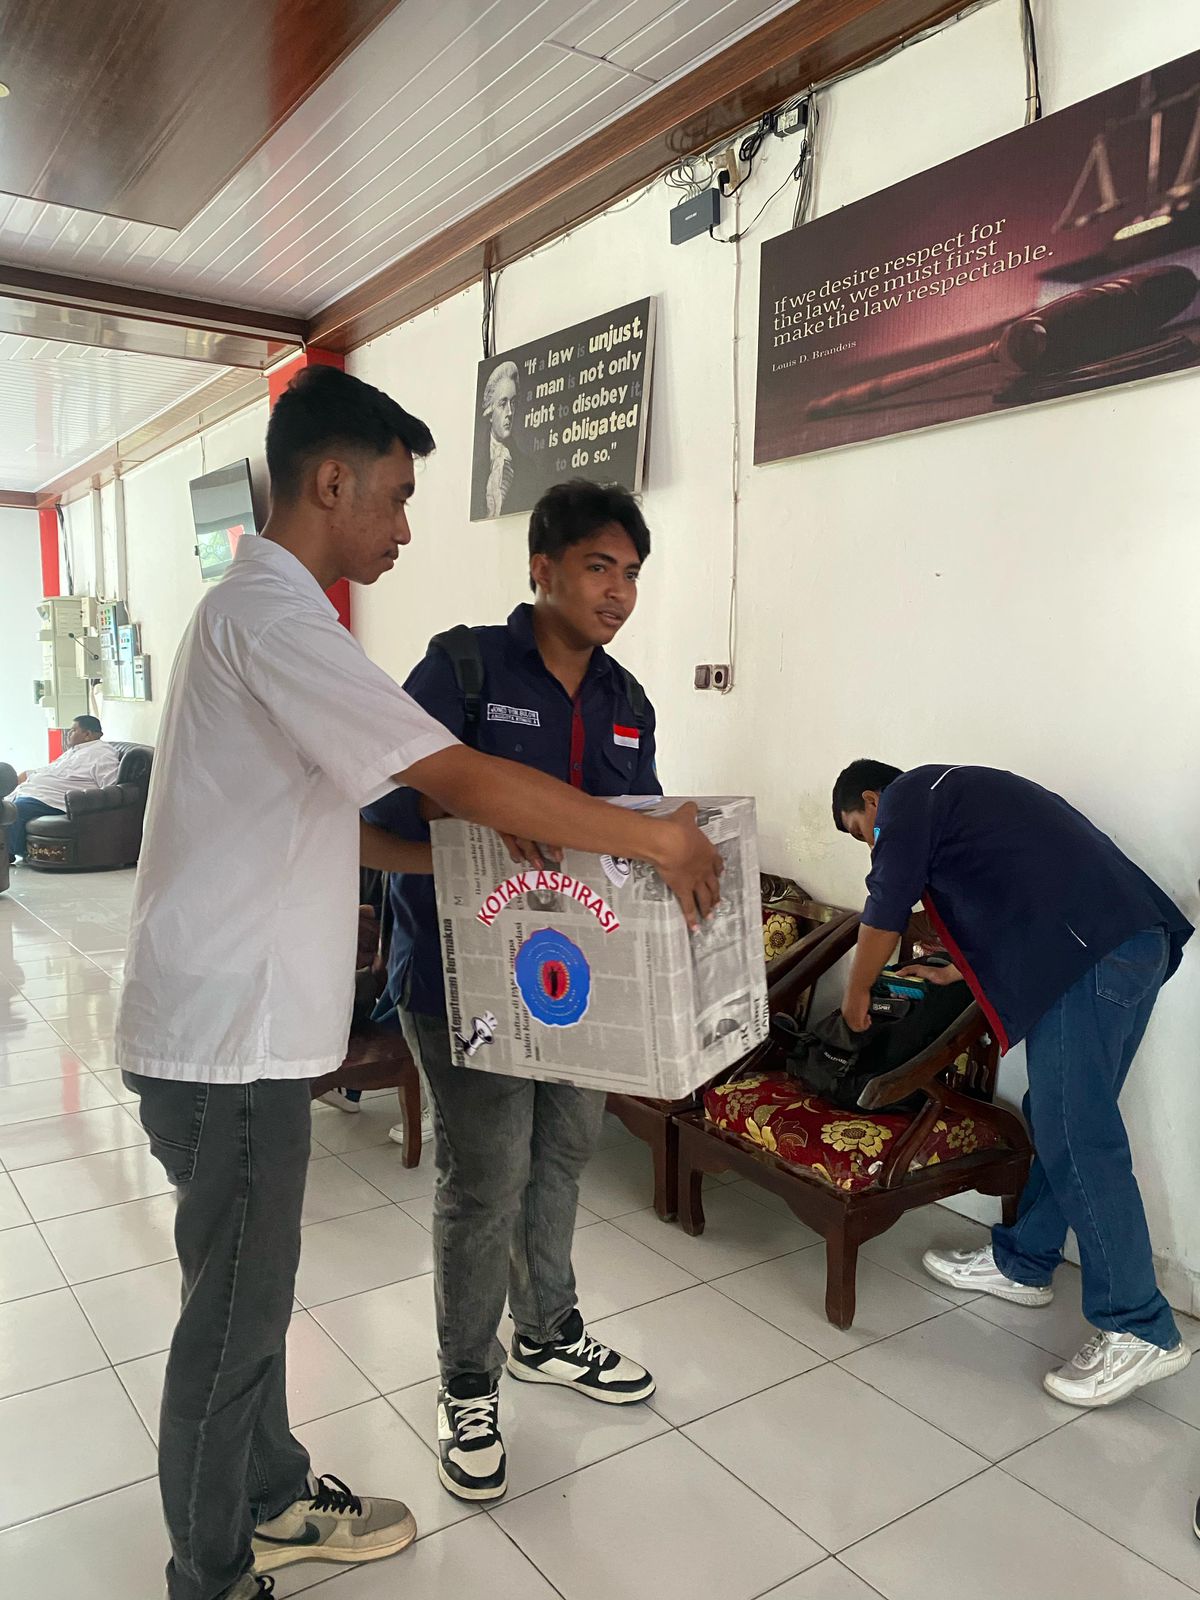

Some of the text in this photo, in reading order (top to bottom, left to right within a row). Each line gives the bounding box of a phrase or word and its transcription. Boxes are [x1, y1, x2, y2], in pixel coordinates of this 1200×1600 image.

[773, 239, 998, 331] the law, we must first
[774, 217, 1006, 315] If we desire respect for
[773, 244, 1054, 348] make the law respectable.
[547, 346, 574, 368] law
[588, 315, 643, 353] unjust,
[772, 340, 857, 373] Louis D. Brandeis
[535, 377, 564, 398] man
[579, 359, 604, 385] not
[608, 350, 642, 375] only
[524, 403, 555, 428] right
[558, 403, 569, 418] to
[572, 384, 628, 414] disobey
[548, 429, 558, 448] is
[562, 403, 638, 444] obligated
[556, 441, 617, 472] to do so."
[477, 872, 531, 926] KOTAK
[536, 871, 620, 933] ASPIRASI
[442, 918, 457, 975] Bermakna
[447, 976, 462, 1033] Keputusan
